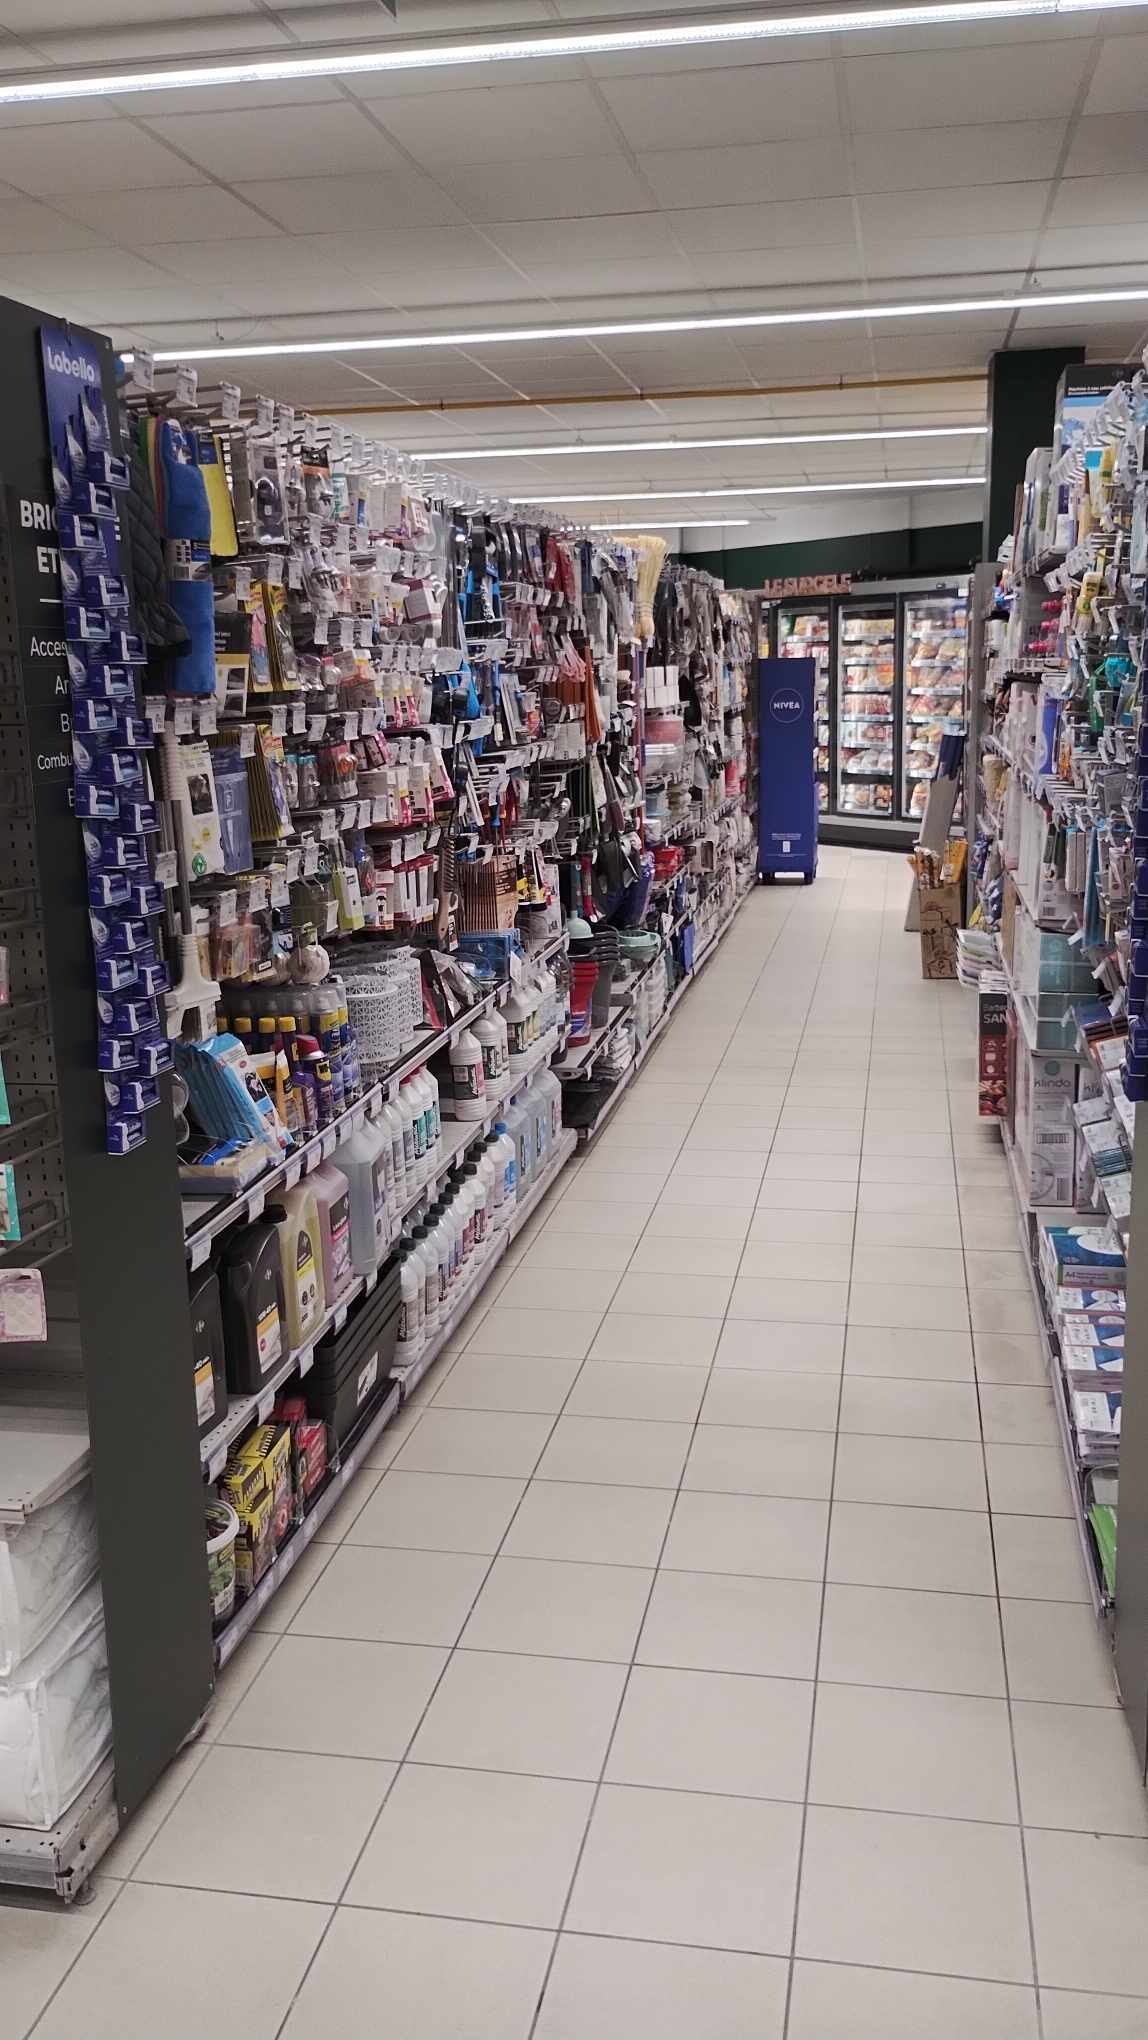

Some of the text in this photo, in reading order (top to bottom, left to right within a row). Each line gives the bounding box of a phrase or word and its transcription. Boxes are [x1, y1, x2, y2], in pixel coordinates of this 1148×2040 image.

[47, 346, 95, 382] Labello
[37, 546, 59, 574] ET
[773, 701, 800, 710] NIVEA
[61, 713, 72, 733] B
